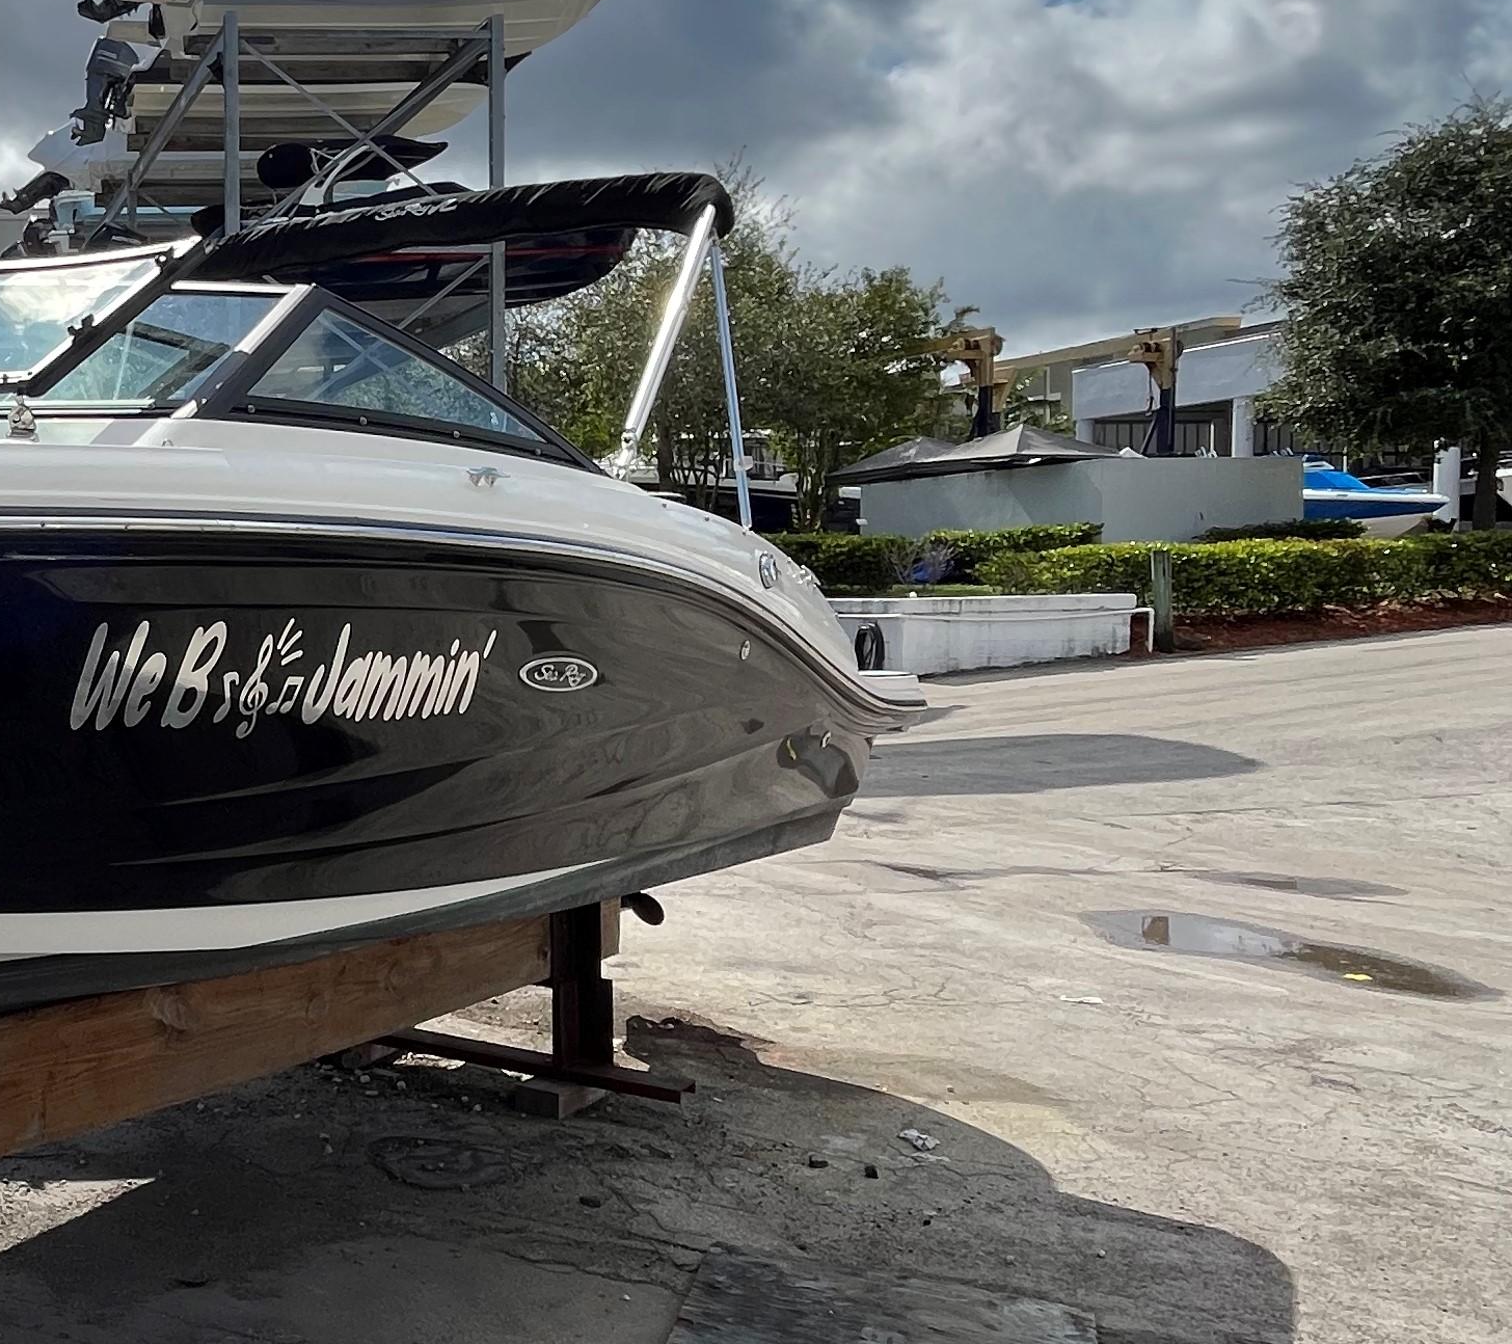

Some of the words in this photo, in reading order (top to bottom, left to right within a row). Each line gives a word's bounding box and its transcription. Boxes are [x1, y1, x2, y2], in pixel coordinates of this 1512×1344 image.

[70, 619, 167, 731] We
[160, 619, 229, 729] B
[300, 621, 498, 725] Jammin'
